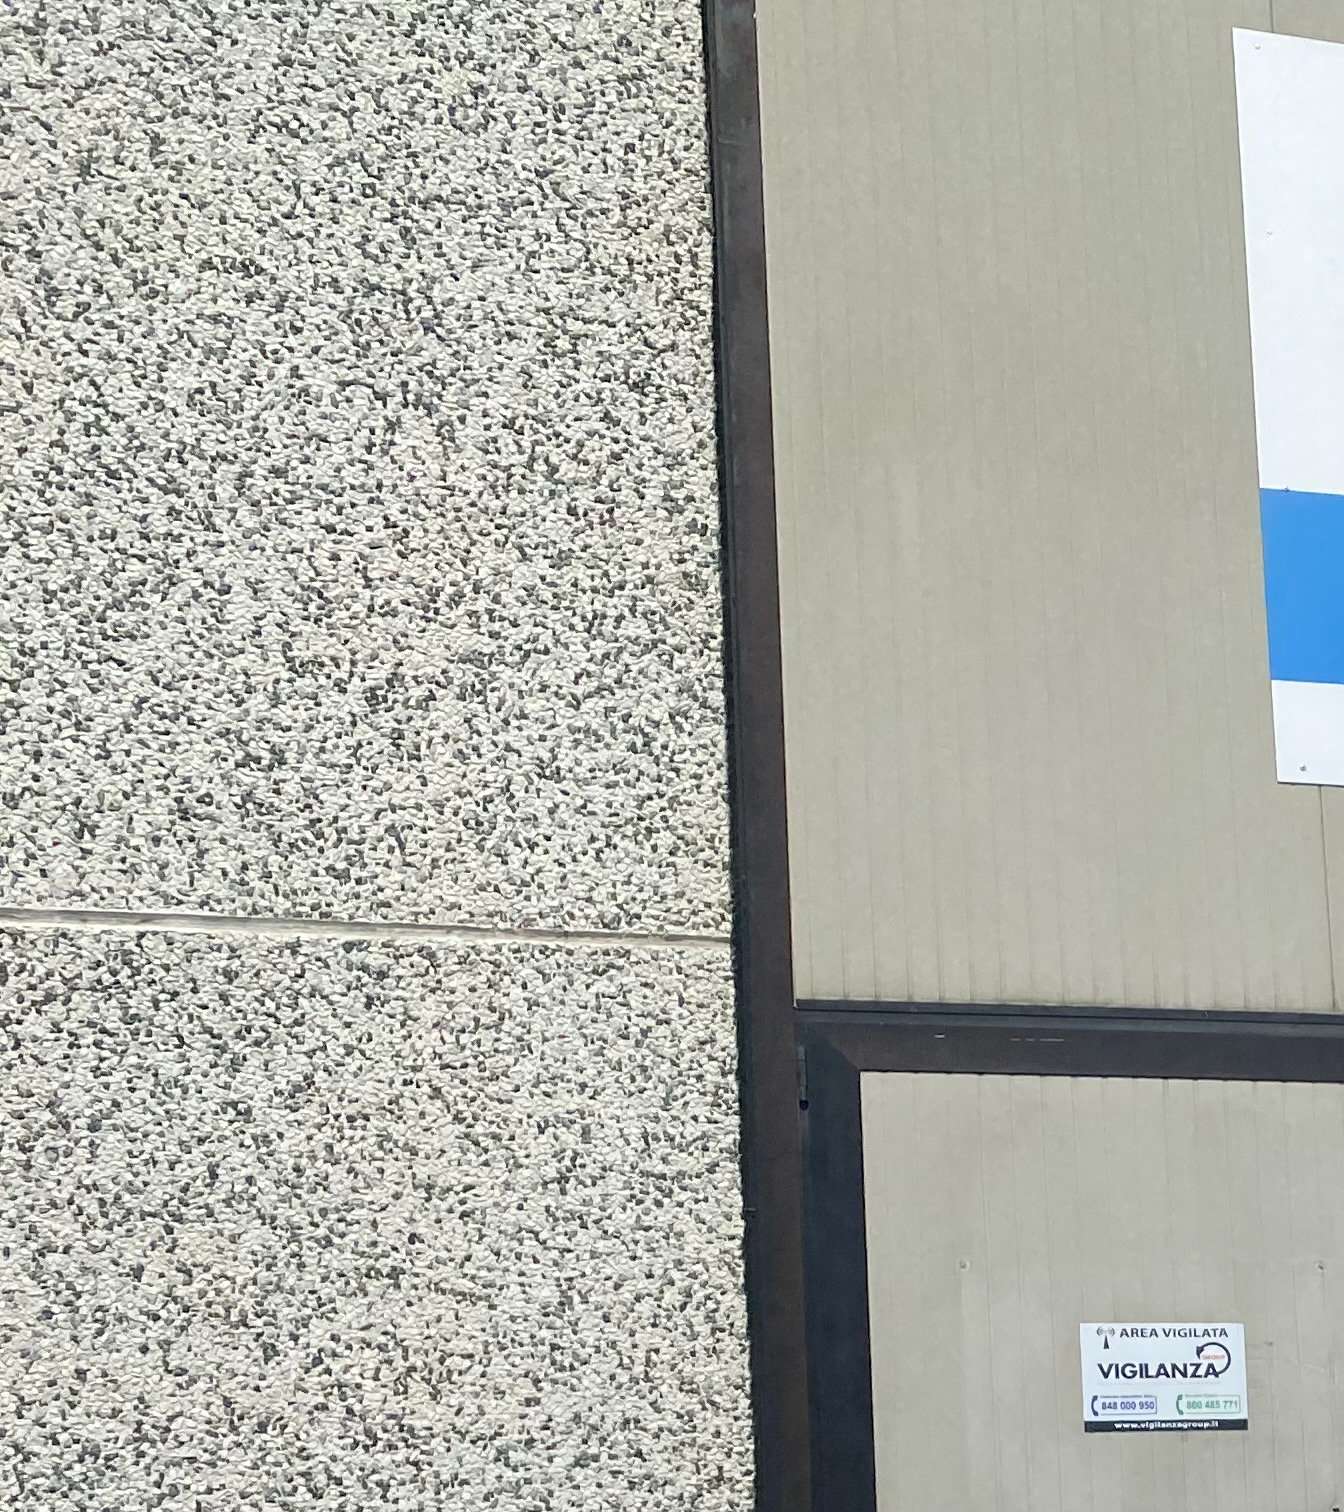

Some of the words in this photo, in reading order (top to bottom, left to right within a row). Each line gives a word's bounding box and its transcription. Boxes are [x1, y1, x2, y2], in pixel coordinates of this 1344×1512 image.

[1119, 1327, 1159, 1338] AREA
[1162, 1327, 1229, 1338] VIGILATA
[1097, 1363, 1220, 1379] VIGILANZA
[1120, 1401, 1136, 1410] 000
[1138, 1401, 1155, 1410] 950
